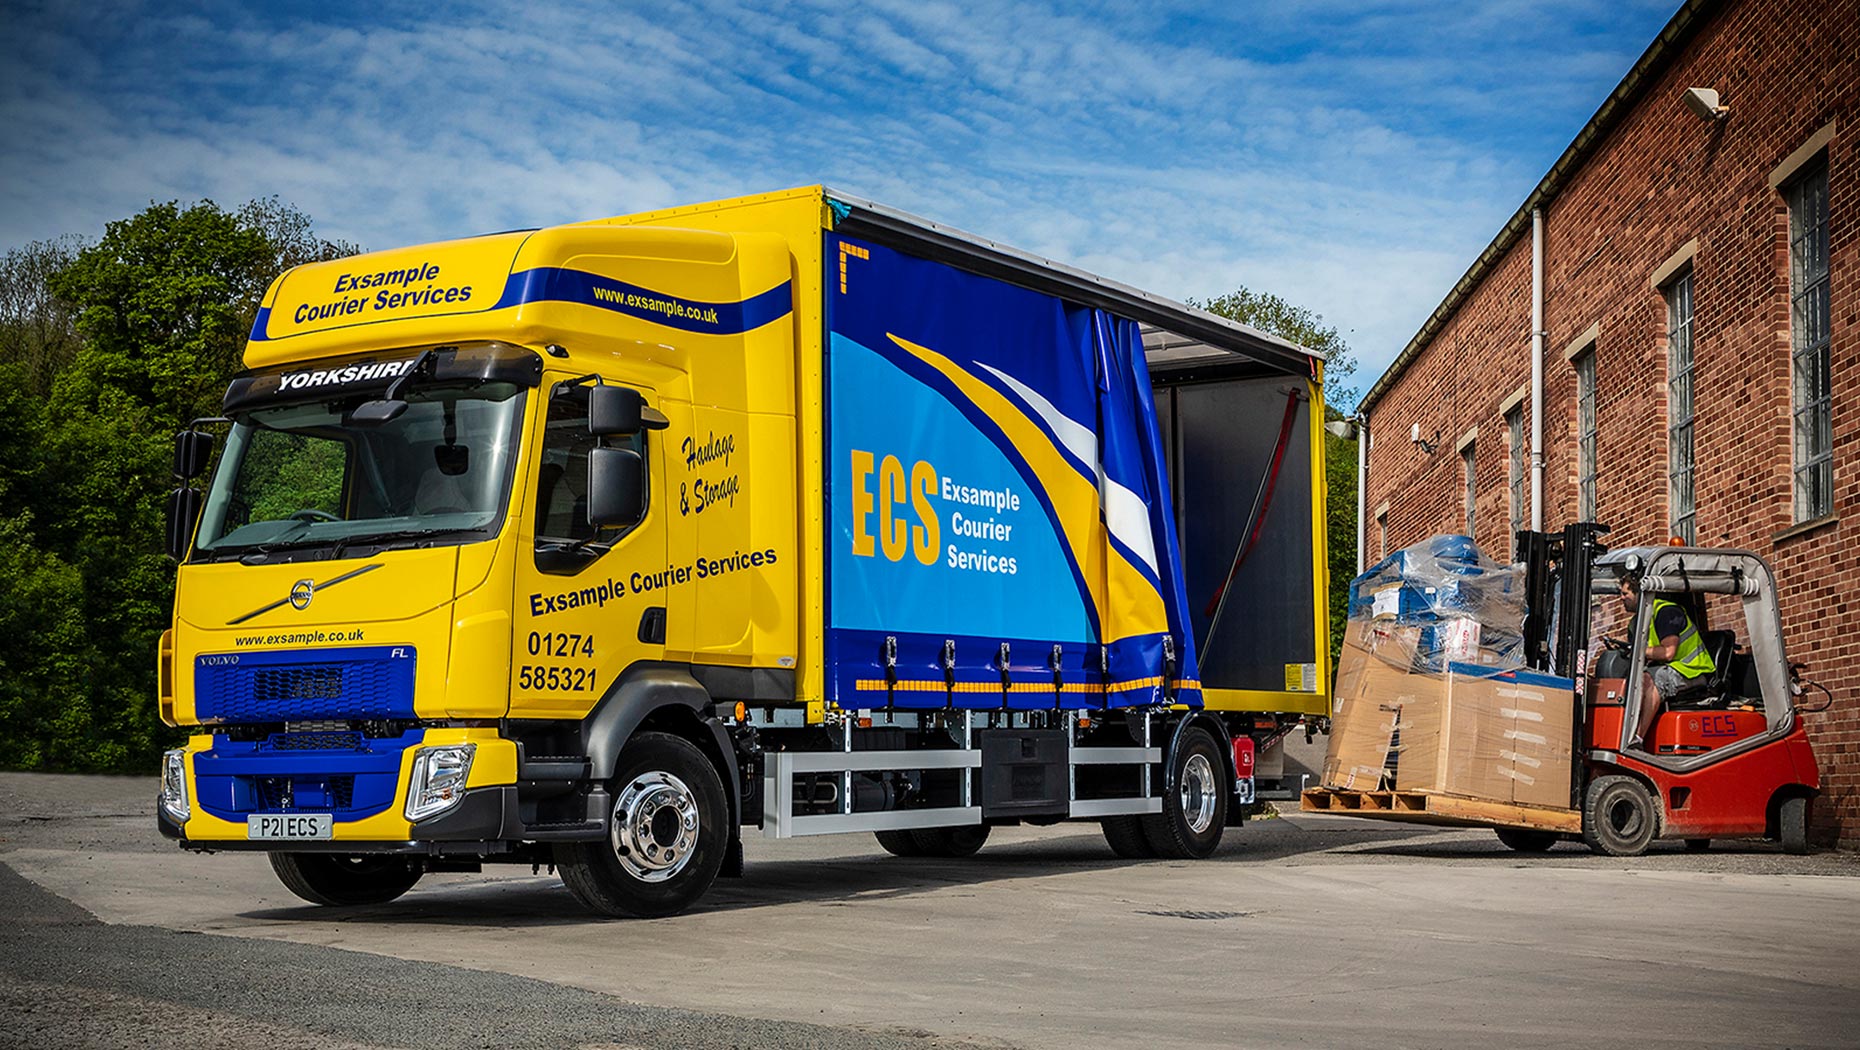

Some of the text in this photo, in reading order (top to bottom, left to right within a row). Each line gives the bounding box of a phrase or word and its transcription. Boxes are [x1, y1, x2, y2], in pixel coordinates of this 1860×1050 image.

[334, 262, 440, 294] Exsample
[294, 285, 472, 324] Courier Services
[592, 286, 719, 324] www.exsample.co.uk
[682, 430, 735, 472] Haulage
[680, 474, 740, 517] & Storage
[851, 449, 940, 566] ECS
[942, 476, 1021, 514] Exsample
[952, 511, 1012, 542] Courier
[947, 544, 1018, 575] Services
[530, 548, 778, 617] Exsample Courier Services
[235, 628, 365, 646] www.exsample.co.uk
[527, 631, 595, 658] 01274
[200, 655, 239, 666] VOLVO
[391, 648, 409, 659] FL
[518, 665, 597, 692] 585321
[1702, 714, 1737, 734] ECS
[287, 817, 318, 837] ECS
